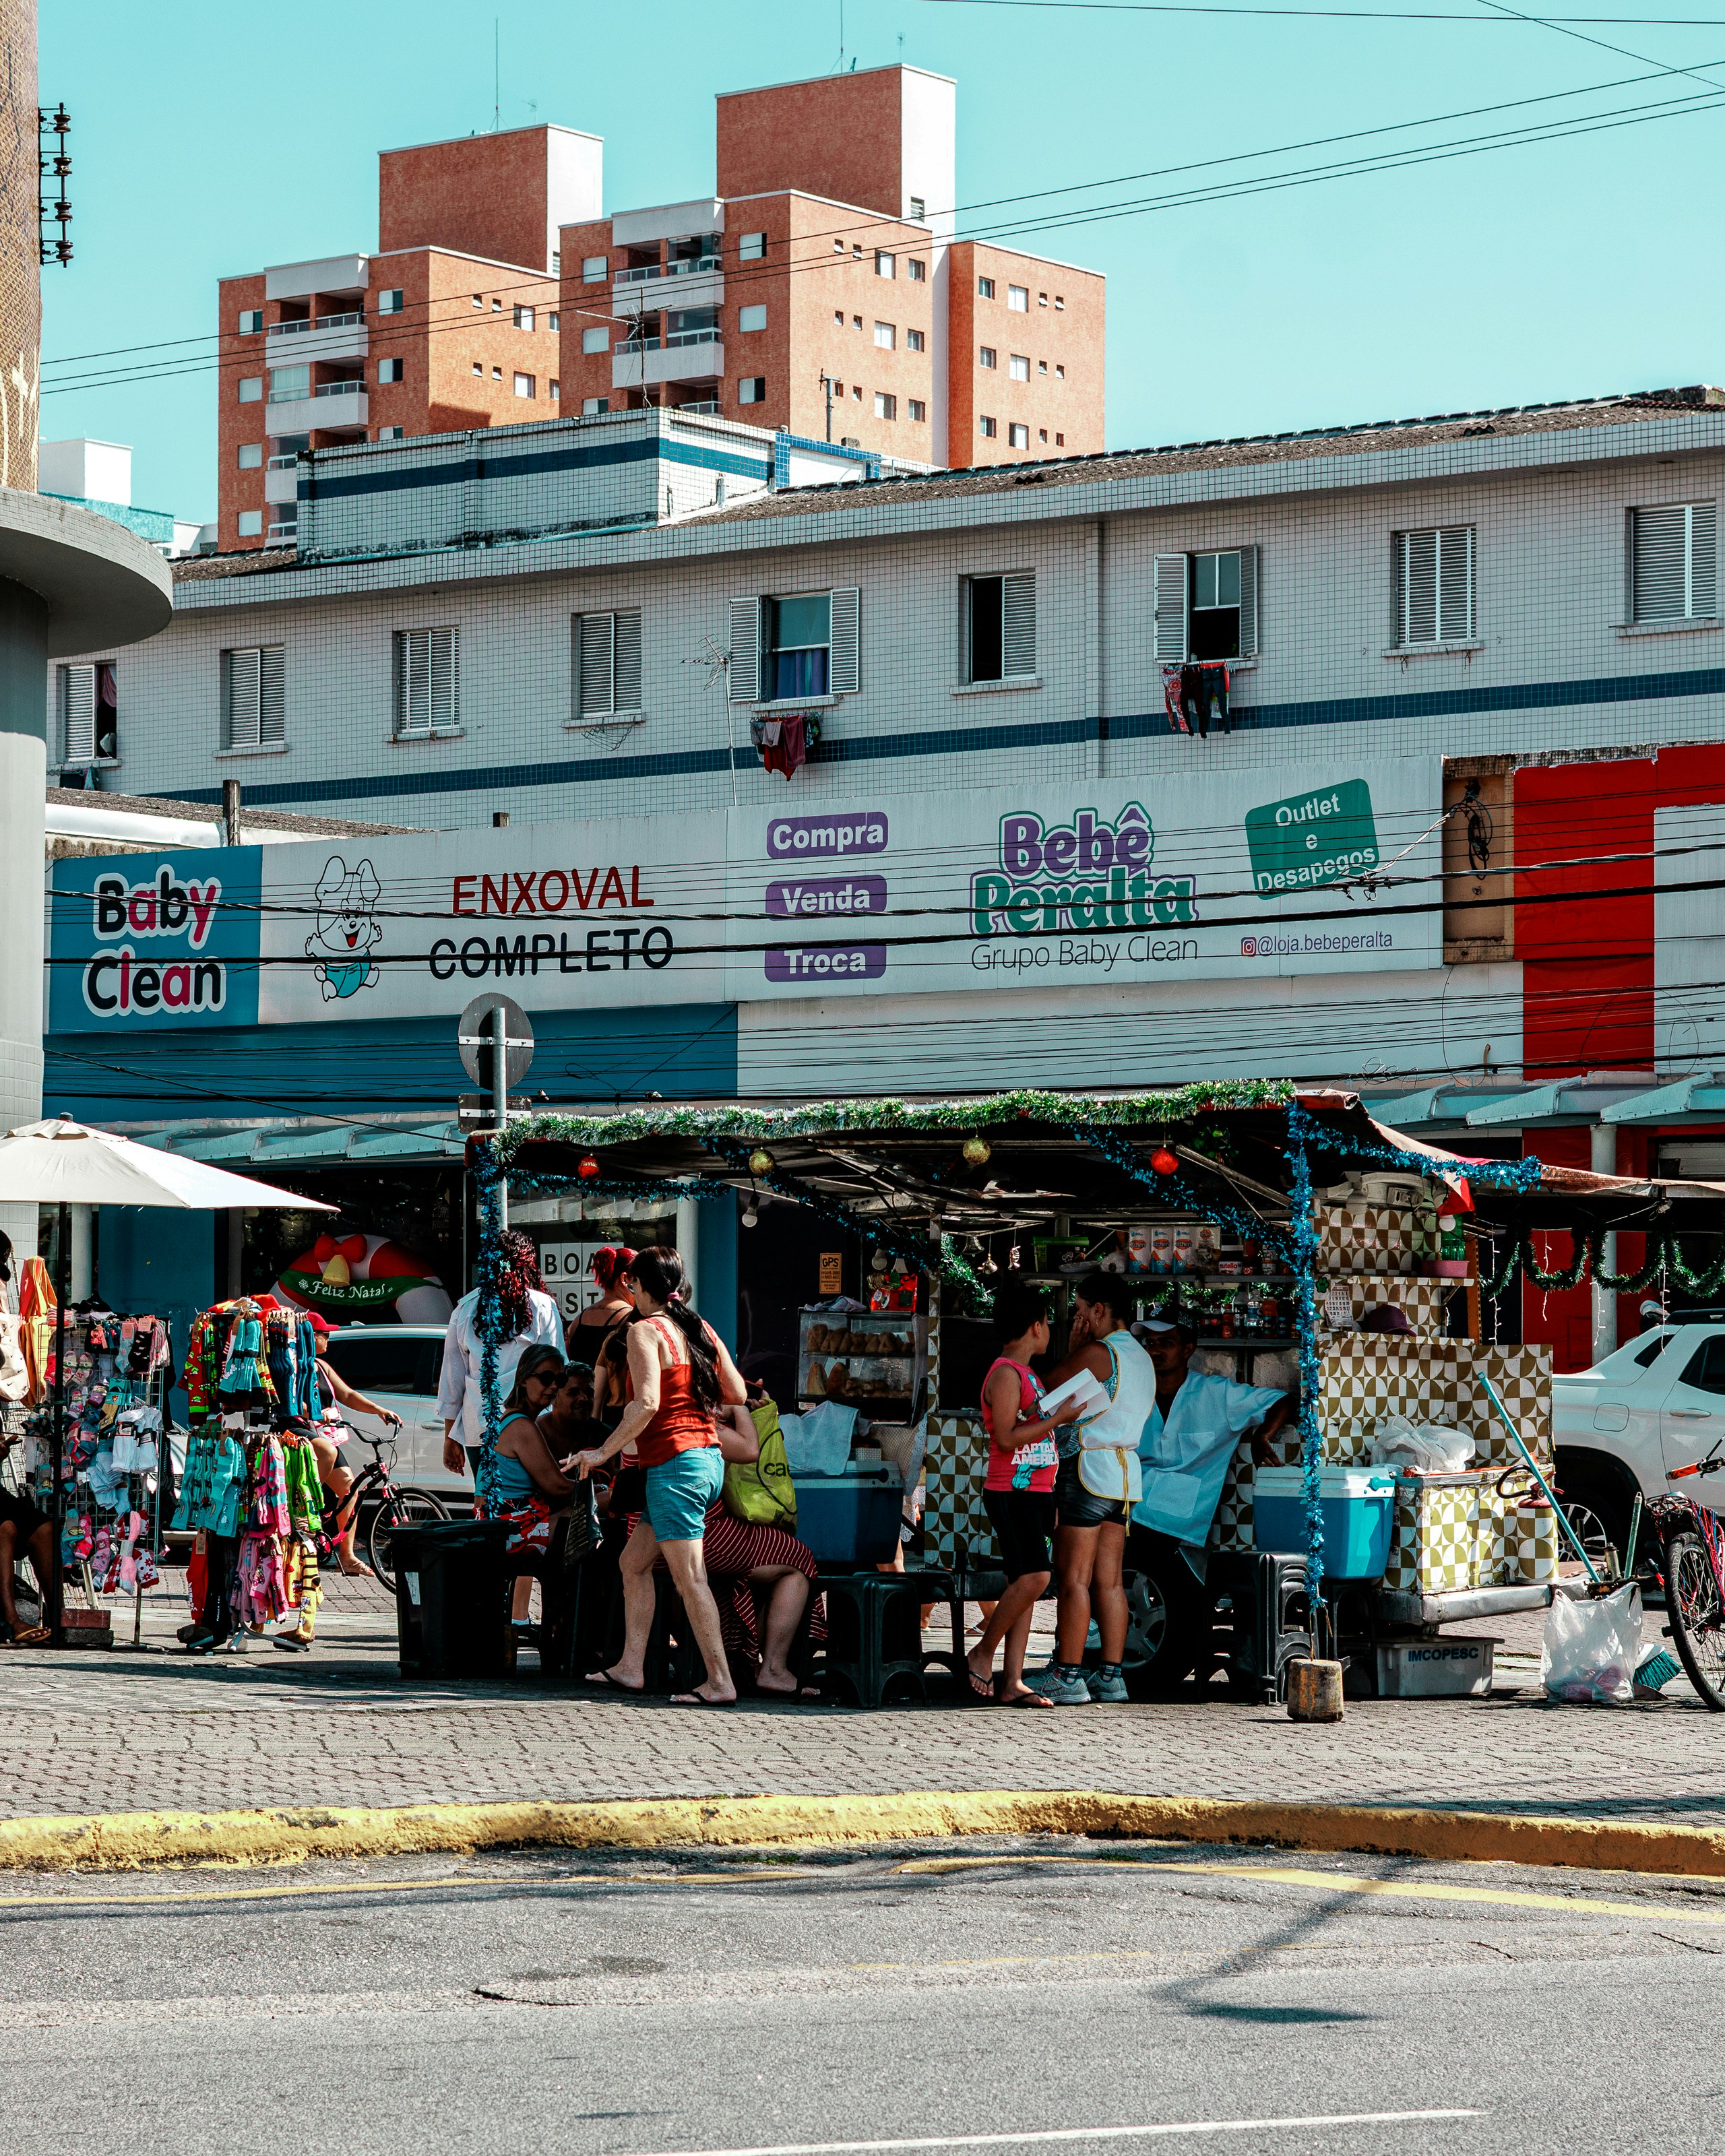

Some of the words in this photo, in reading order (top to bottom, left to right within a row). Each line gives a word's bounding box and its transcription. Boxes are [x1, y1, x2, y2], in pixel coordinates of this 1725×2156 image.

[1275, 793, 1340, 827] Outlet
[773, 823, 883, 852] Compra
[1002, 806, 1151, 879] Bebê
[1305, 834, 1318, 850] e
[1257, 848, 1376, 891] Desapegos
[452, 864, 655, 914] ENXOVAL
[782, 884, 871, 914] Venda
[974, 866, 1195, 934] Peralta
[96, 870, 217, 944] Baby
[429, 926, 674, 980] COMPLETO
[972, 944, 1050, 976] Grupo
[1059, 938, 1121, 972] Baby
[1128, 935, 1198, 962] Clean
[1257, 931, 1393, 956] @loja.bebeperalta
[784, 949, 867, 974] Troca
[87, 951, 222, 1010] Clean
[822, 1257, 840, 1267] GPS
[309, 1281, 344, 1298] Feliz
[348, 1284, 385, 1298] Natal
[1408, 1647, 1479, 1662] IMCOPESC
